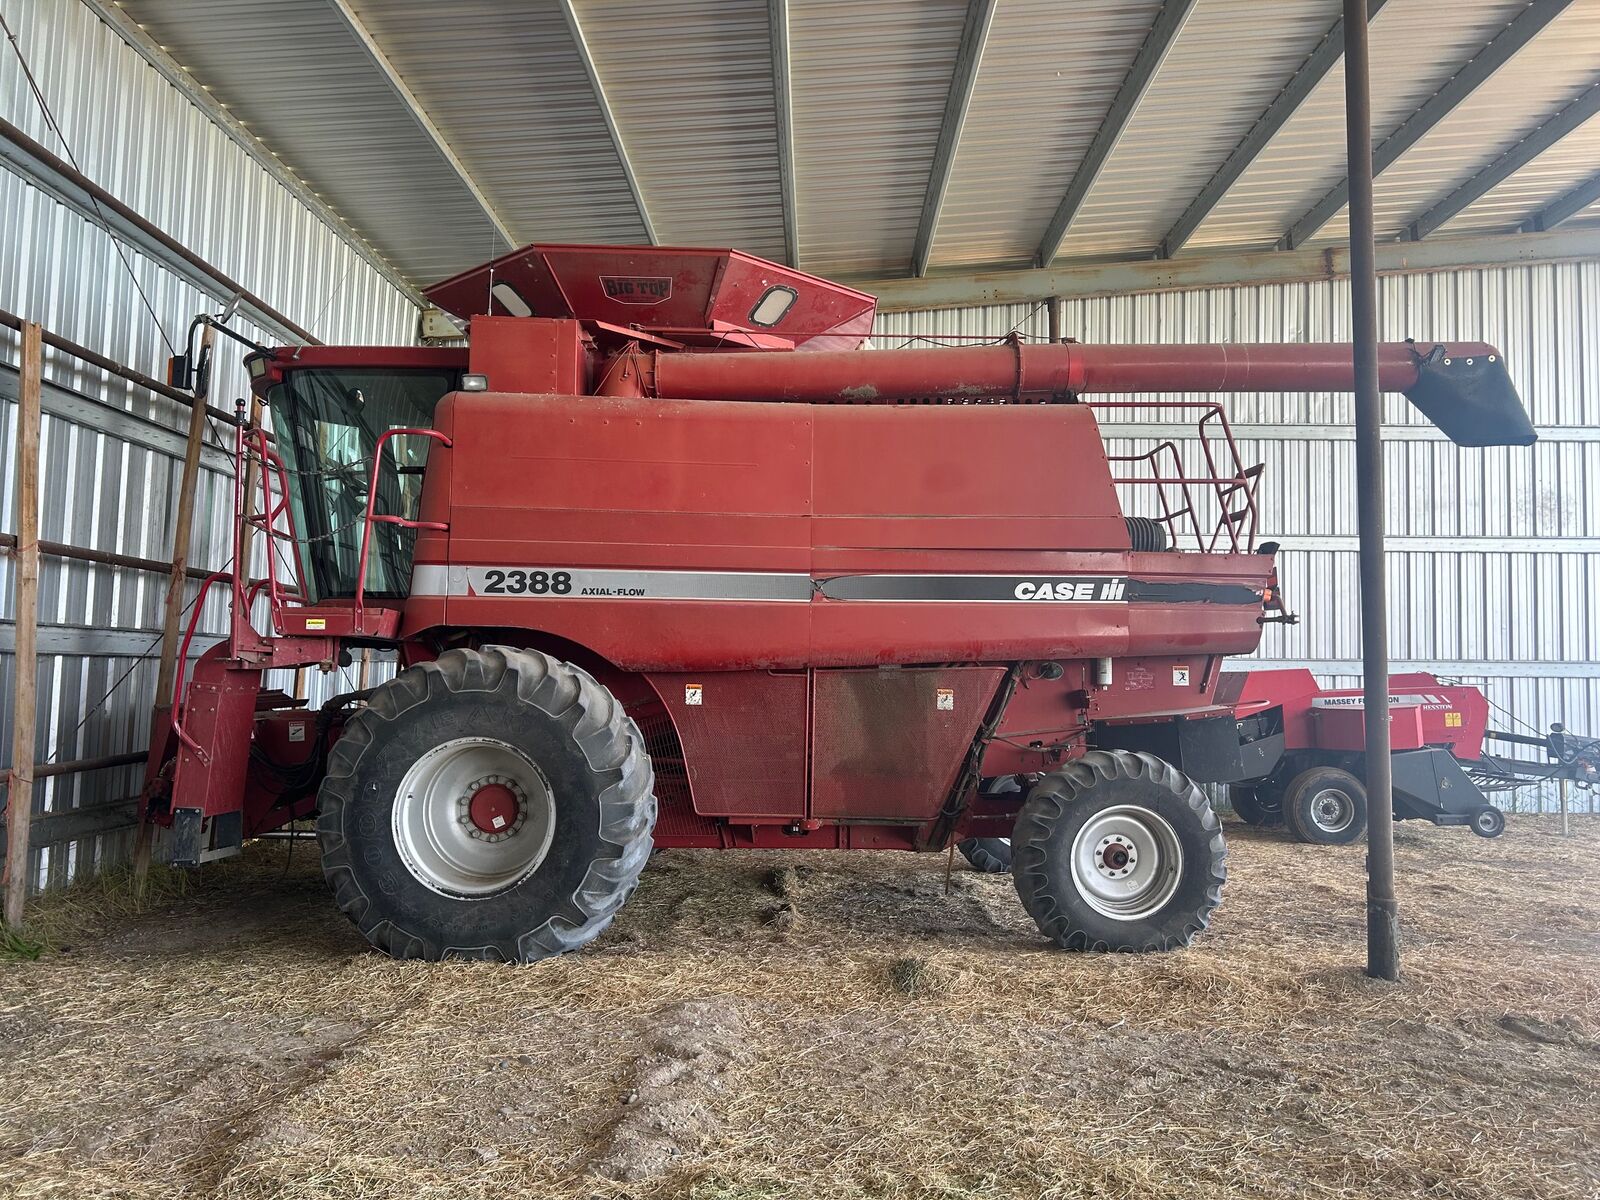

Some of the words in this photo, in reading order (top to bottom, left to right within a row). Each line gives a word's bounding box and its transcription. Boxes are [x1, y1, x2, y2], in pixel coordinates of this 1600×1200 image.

[606, 280, 634, 296] BIG
[637, 280, 669, 297] TOP
[484, 570, 572, 594] 2388
[581, 588, 645, 596] AXIAL-FLOW
[1014, 582, 1095, 600] CASE
[1324, 698, 1356, 706] MASSEY
